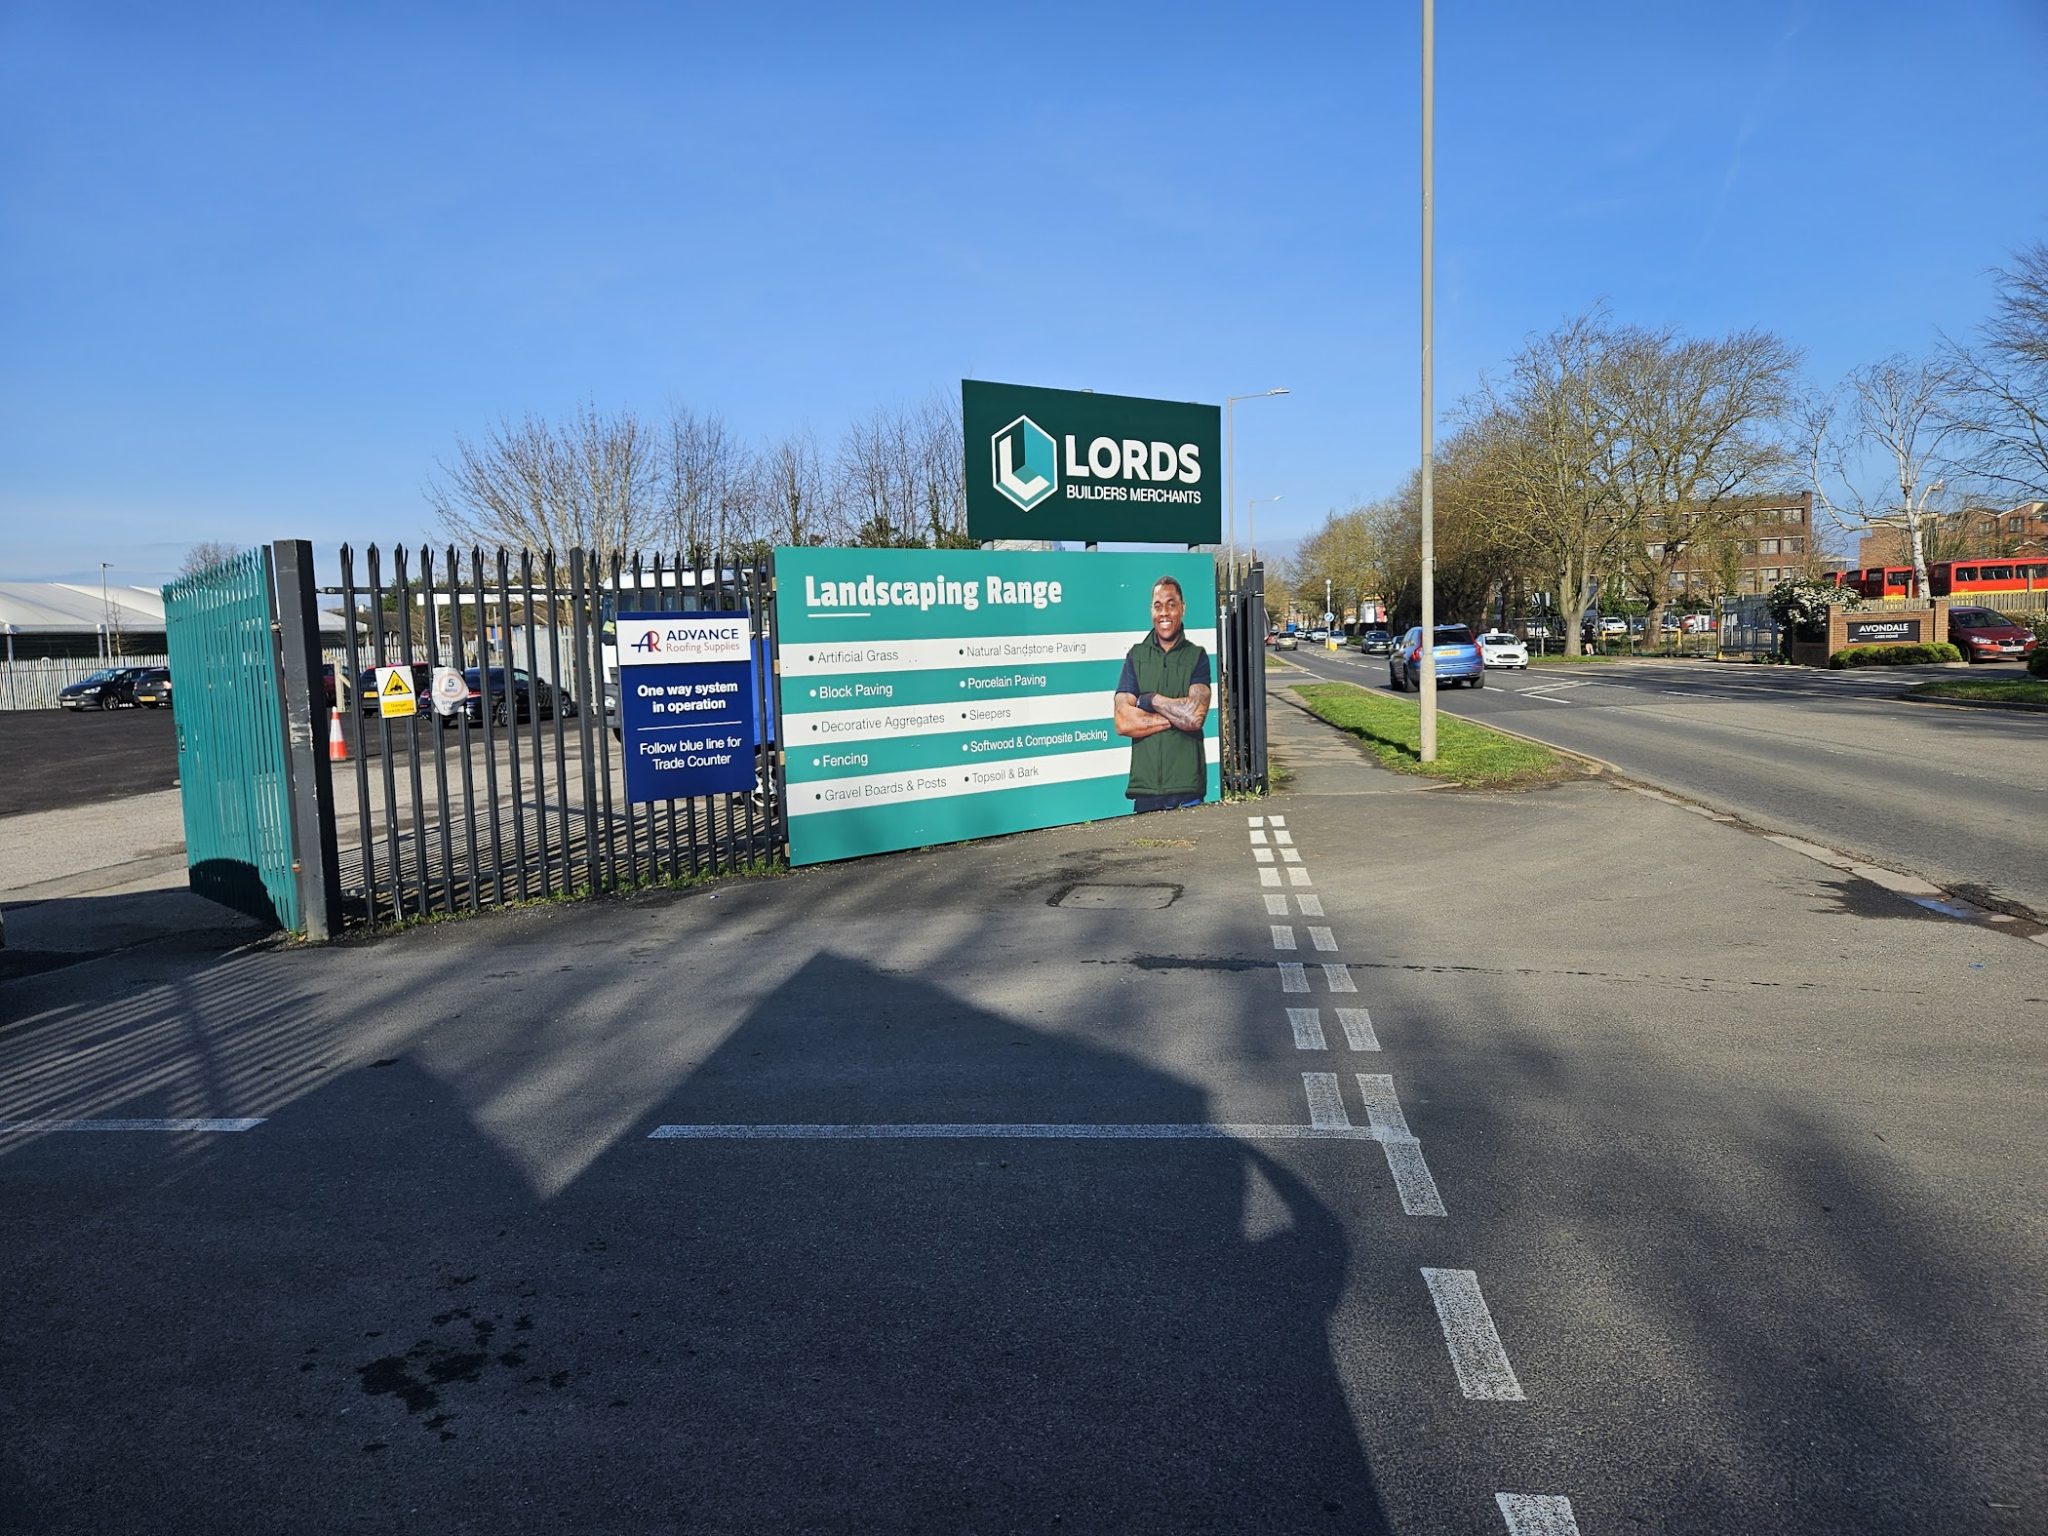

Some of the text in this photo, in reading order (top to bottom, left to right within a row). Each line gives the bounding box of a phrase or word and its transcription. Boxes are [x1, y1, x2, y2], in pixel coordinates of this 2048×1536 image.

[1065, 434, 1202, 484] LORDS
[1066, 484, 1202, 504] BUILDERS MERCHANTS
[805, 574, 1062, 611] Landscaping Range
[666, 628, 739, 641] ADVANCE
[1858, 622, 1909, 632] AVONDALE
[666, 642, 740, 654] Roofing Supplies
[966, 641, 1087, 657] Natural Sandstone Paving
[817, 650, 899, 664] Artificial Grass
[448, 678, 455, 688] 5
[637, 682, 738, 697] One way system
[967, 675, 1046, 689] Porcelain Paving
[819, 683, 893, 699] Block Paving
[652, 698, 726, 714] in operation
[969, 707, 1012, 722] Sleepers
[821, 713, 945, 733] Decorative Aggregates
[639, 736, 742, 755] Follow blue line for
[970, 729, 1108, 752] Softwood & Composite Decking
[652, 754, 731, 771] Trade Counter
[822, 753, 869, 768] Fencing
[972, 765, 1040, 784] Topsoil & Bark
[824, 776, 947, 802] Gravel Boards & Posts
